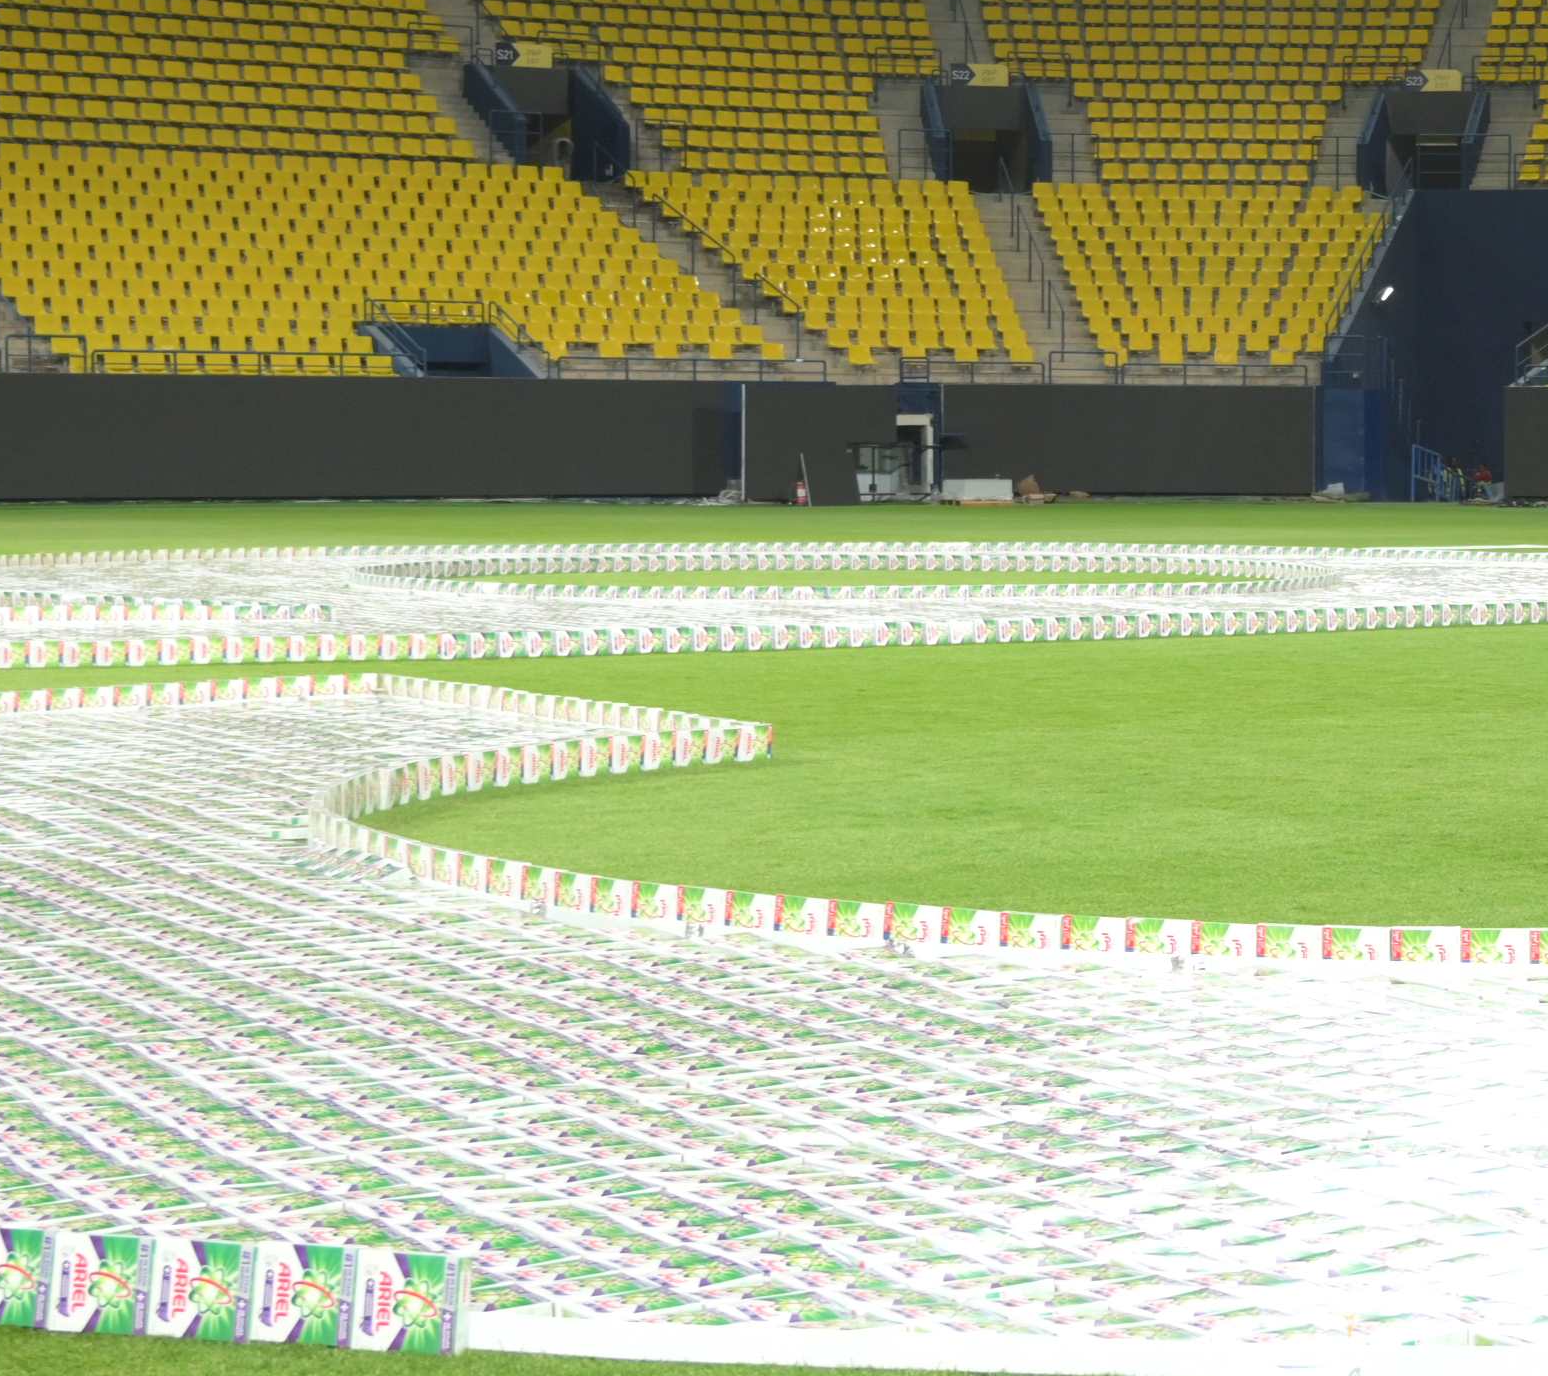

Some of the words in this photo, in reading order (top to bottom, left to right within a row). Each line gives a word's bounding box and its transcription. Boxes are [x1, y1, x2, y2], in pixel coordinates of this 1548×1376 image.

[496, 49, 514, 60] S21
[951, 70, 971, 80] S22
[1405, 76, 1424, 87] S23
[72, 1252, 89, 1311] ARIEL
[172, 1258, 190, 1315] ARIEL
[276, 1262, 292, 1321] ARIEL
[376, 1270, 394, 1329] ARIEL
